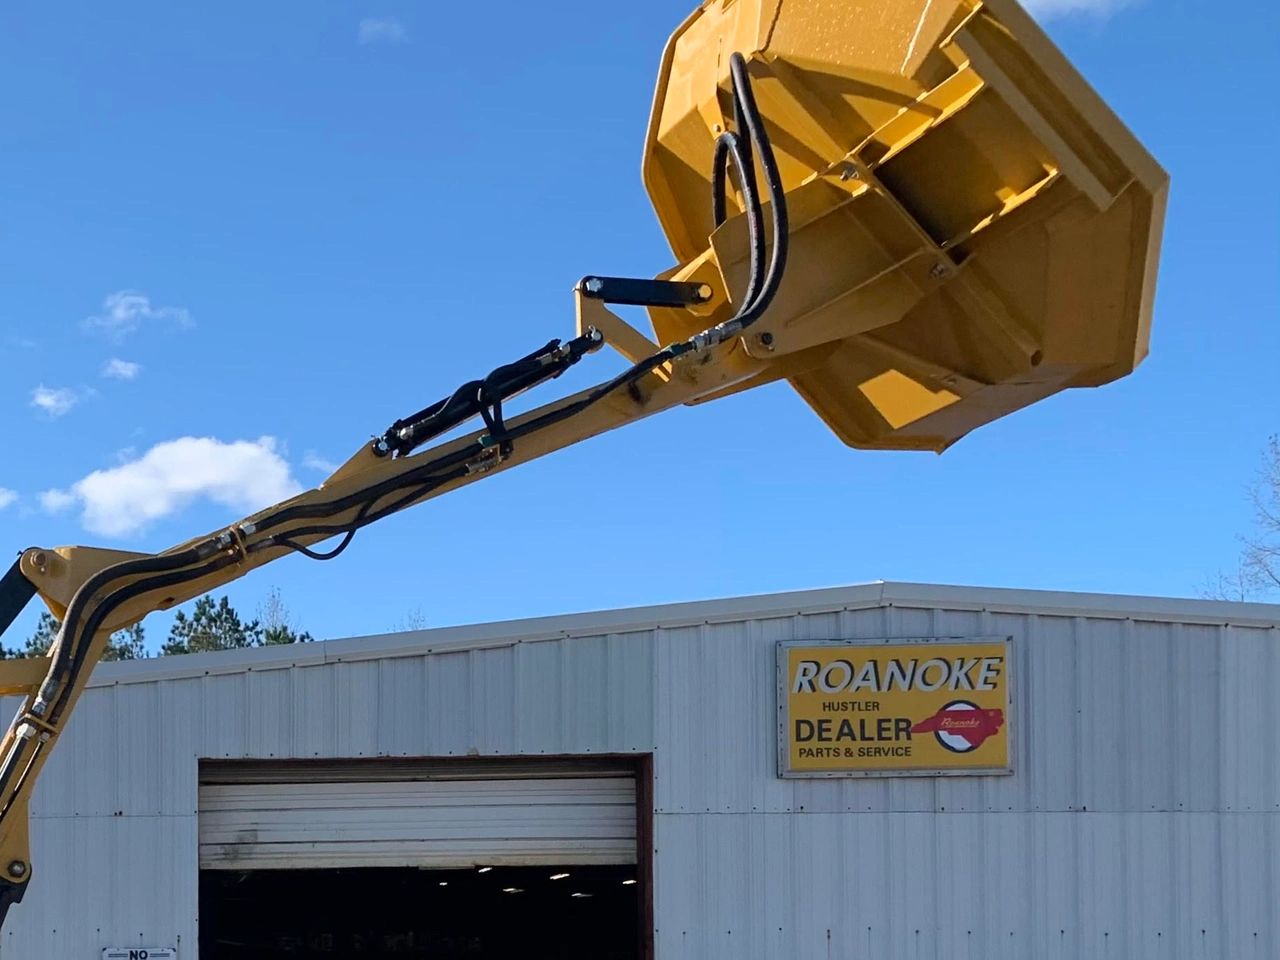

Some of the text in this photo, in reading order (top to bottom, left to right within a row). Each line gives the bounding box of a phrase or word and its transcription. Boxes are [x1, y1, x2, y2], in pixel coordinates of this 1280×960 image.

[791, 656, 1004, 694] ROANOKE
[822, 701, 880, 712] HUSTLER
[941, 717, 981, 728] Roanoke
[795, 717, 913, 743] DEALER
[799, 746, 912, 758] PARTS & SERVICE
[129, 950, 148, 960] NO
